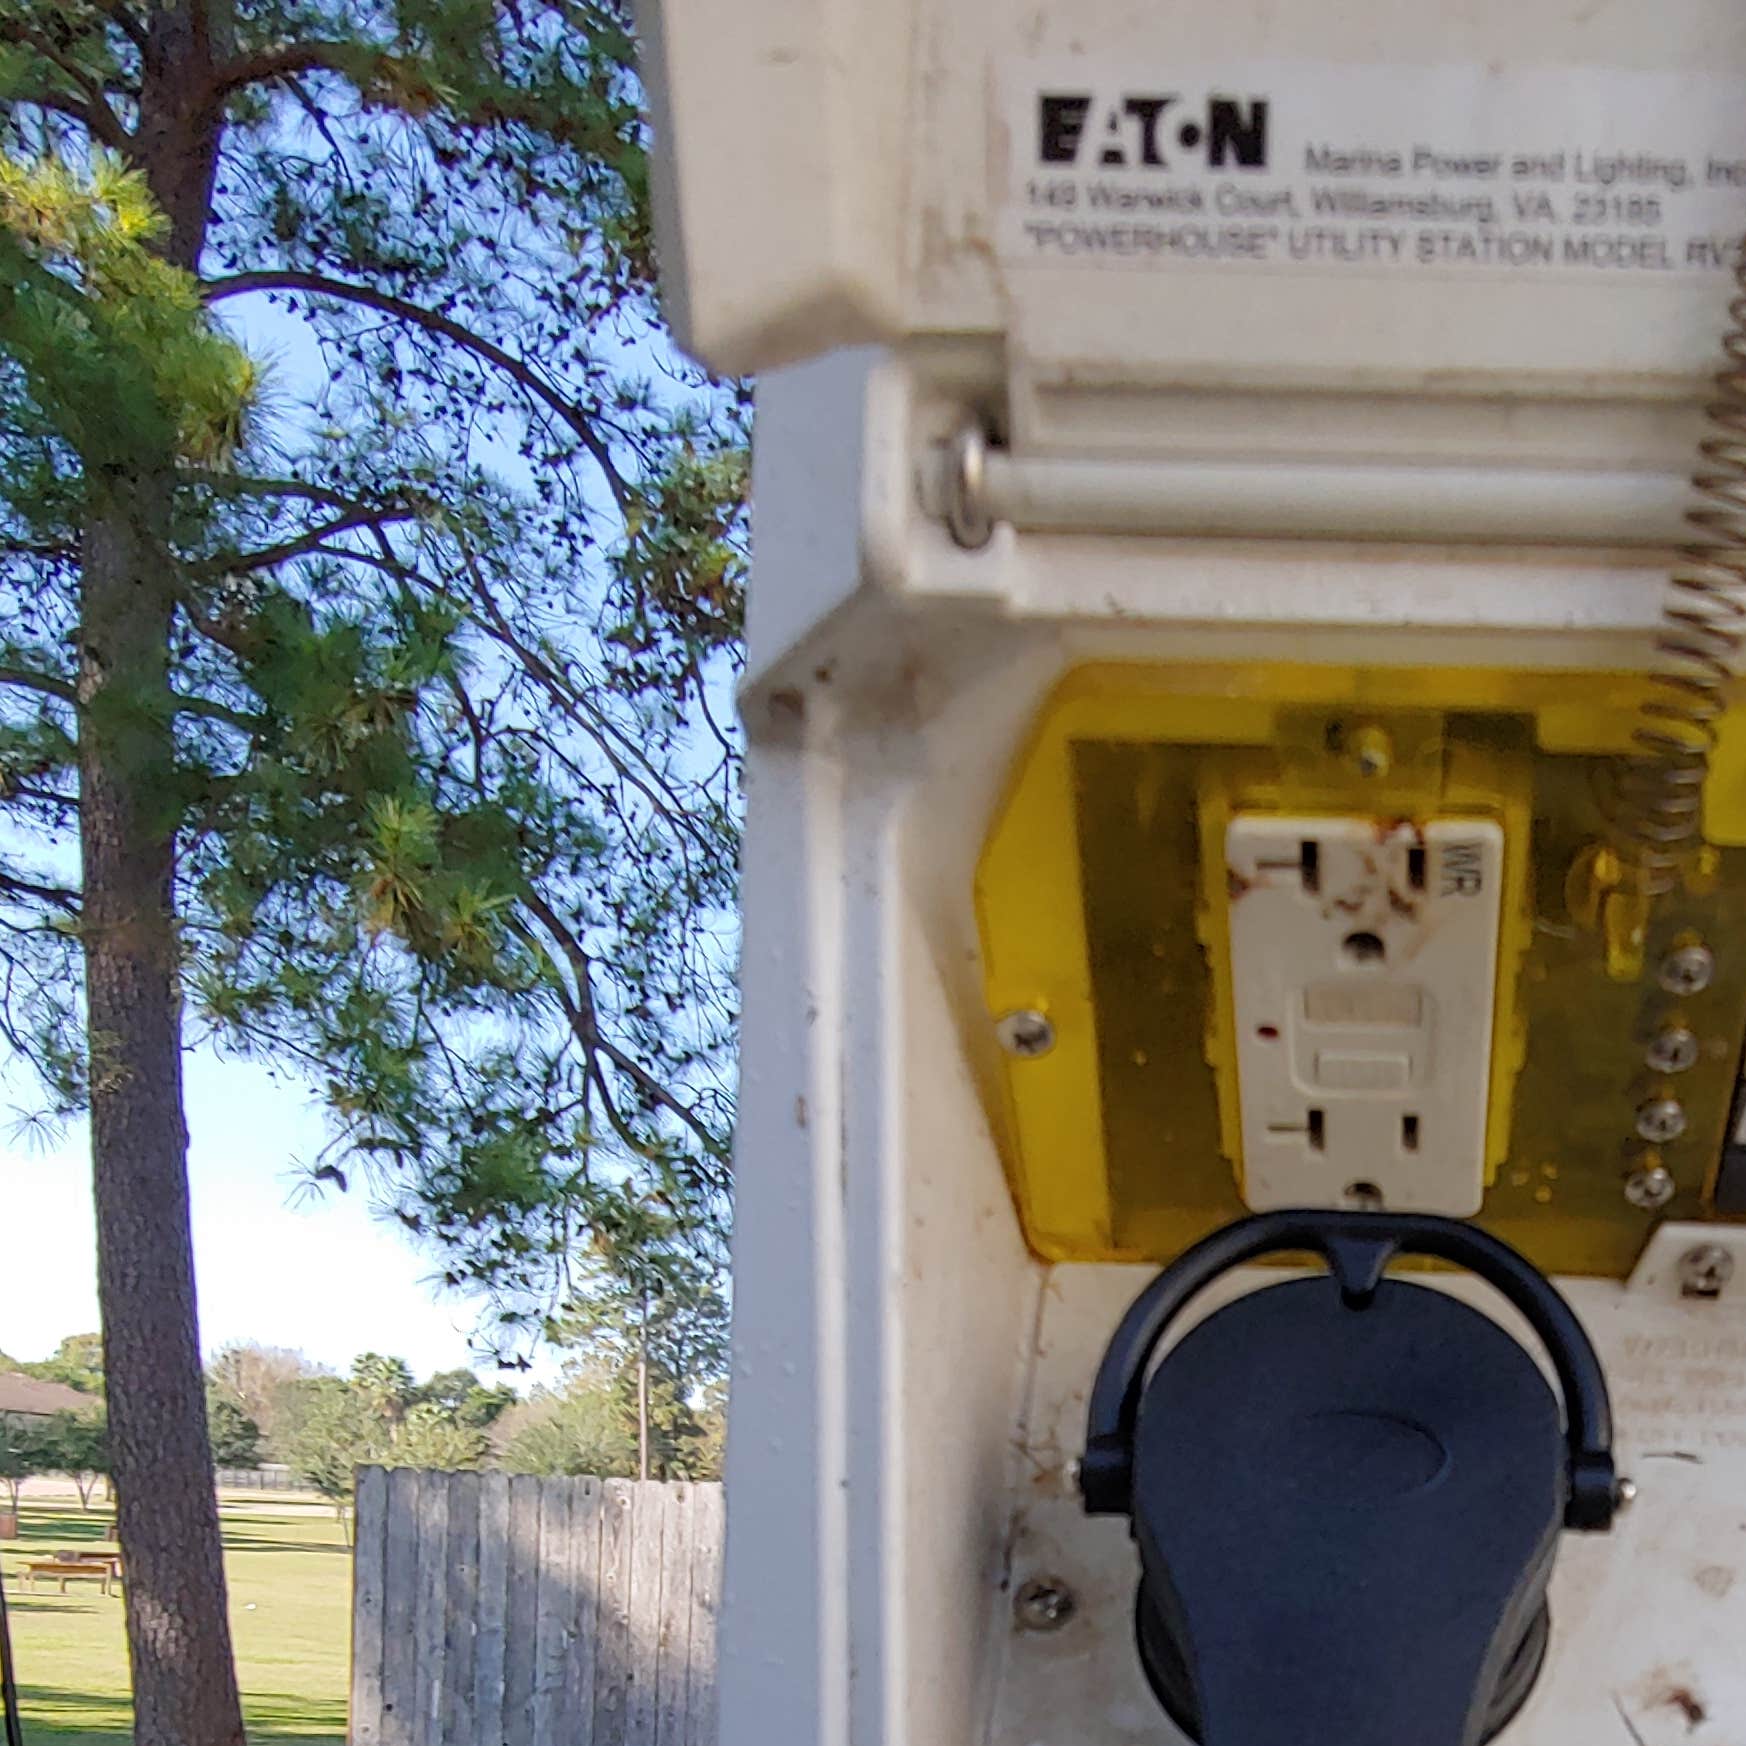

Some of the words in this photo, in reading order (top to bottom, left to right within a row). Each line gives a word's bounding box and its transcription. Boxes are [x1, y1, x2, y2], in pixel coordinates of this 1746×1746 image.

[1036, 92, 1269, 169] EATON
[1412, 145, 1501, 179] Power
[1511, 150, 1565, 182] and
[1414, 229, 1554, 264] STATION
[1563, 234, 1674, 269] MODEL
[1440, 841, 1482, 898] WR
